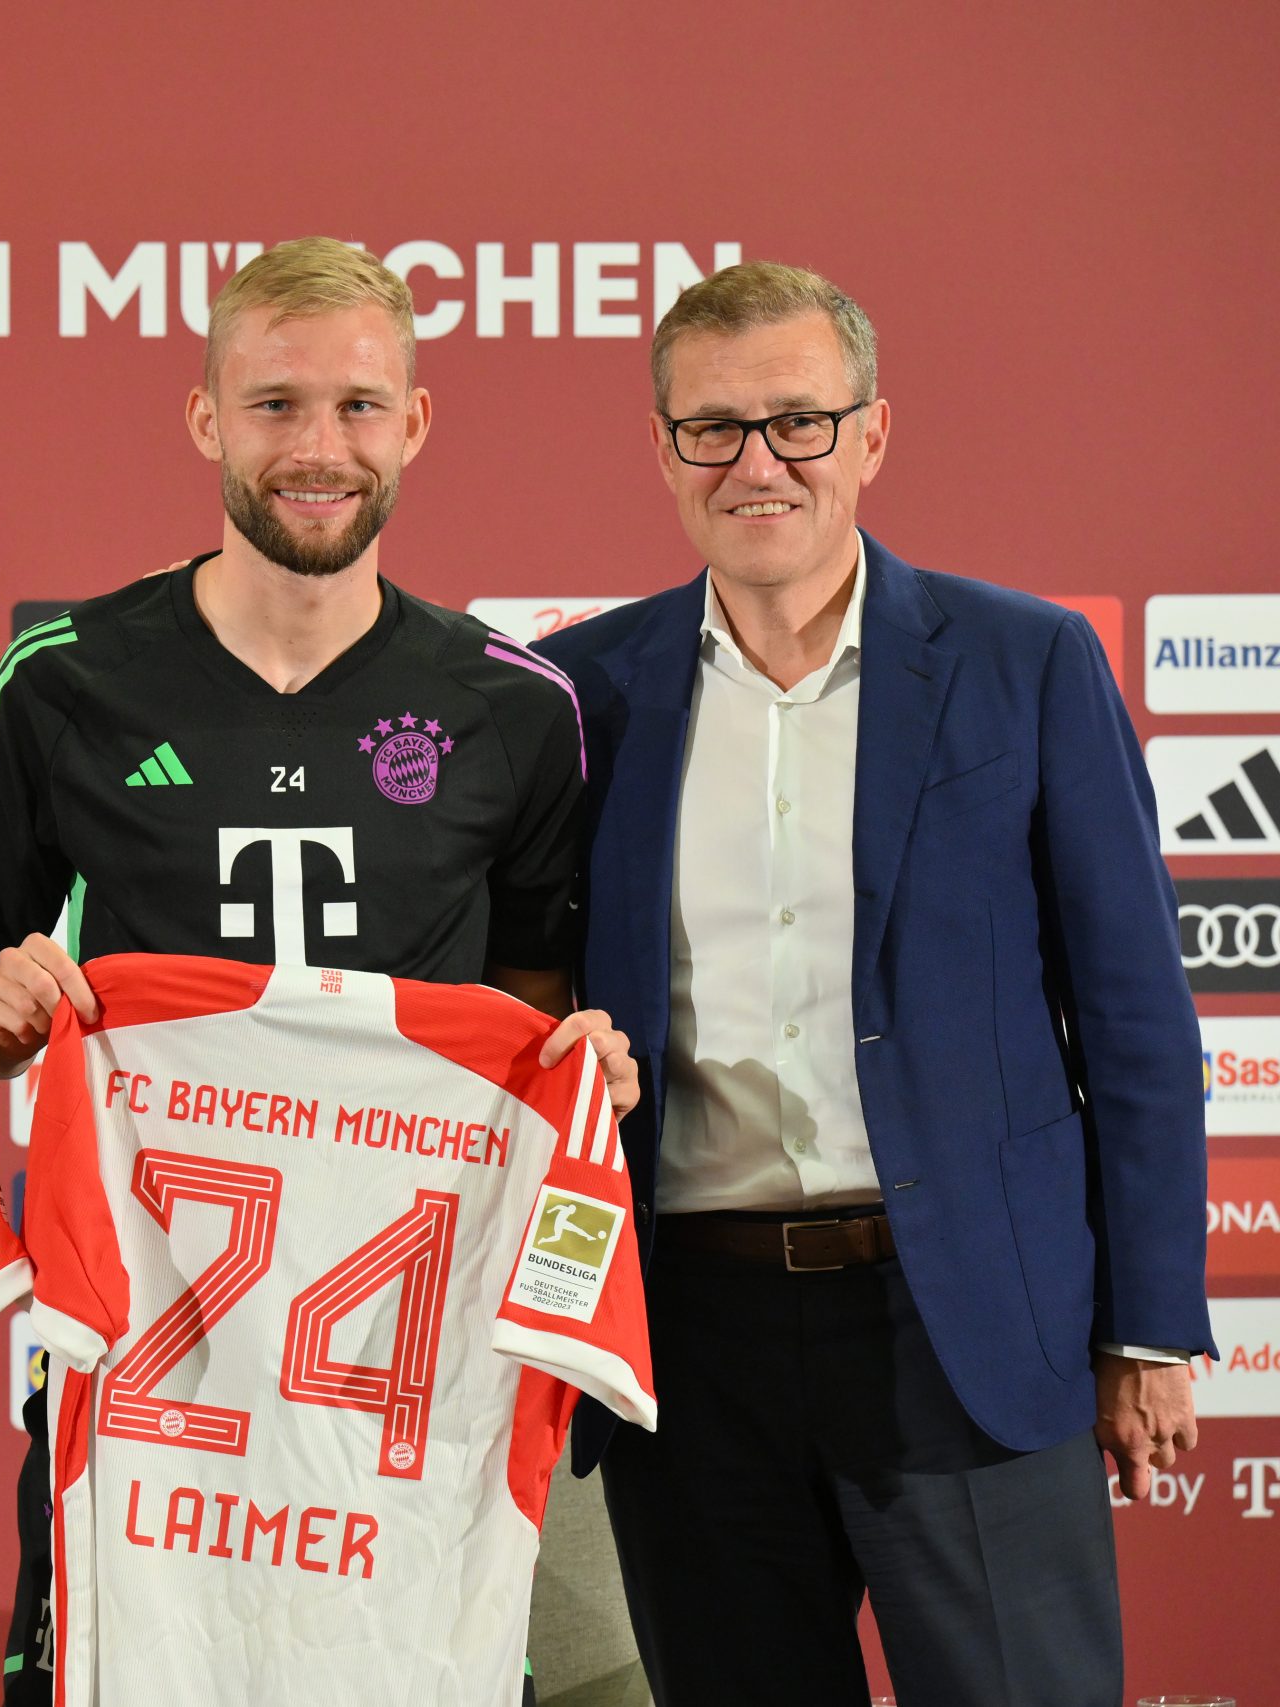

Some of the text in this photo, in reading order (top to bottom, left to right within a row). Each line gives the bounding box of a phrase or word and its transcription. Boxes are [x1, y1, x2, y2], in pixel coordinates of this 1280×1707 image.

[58, 240, 742, 340] MÜCHEN
[1154, 637, 1280, 669] Allianz
[380, 738, 437, 765] FC BAYERN
[270, 766, 306, 793] 24
[320, 982, 342, 994] MIA
[1216, 1051, 1280, 1087] Sas
[105, 1069, 511, 1168] FC BAYERN MÜNCHEN
[527, 1253, 597, 1283] BUNDESLIGA
[519, 1282, 589, 1308] FUSSBALLMEISTER
[532, 1294, 572, 1310] 2022/2023
[534, 1279, 579, 1298] DEUTSCHER
[96, 1147, 461, 1481] 24
[1150, 1465, 1205, 1516] by
[125, 1479, 380, 1580] LAIMER
